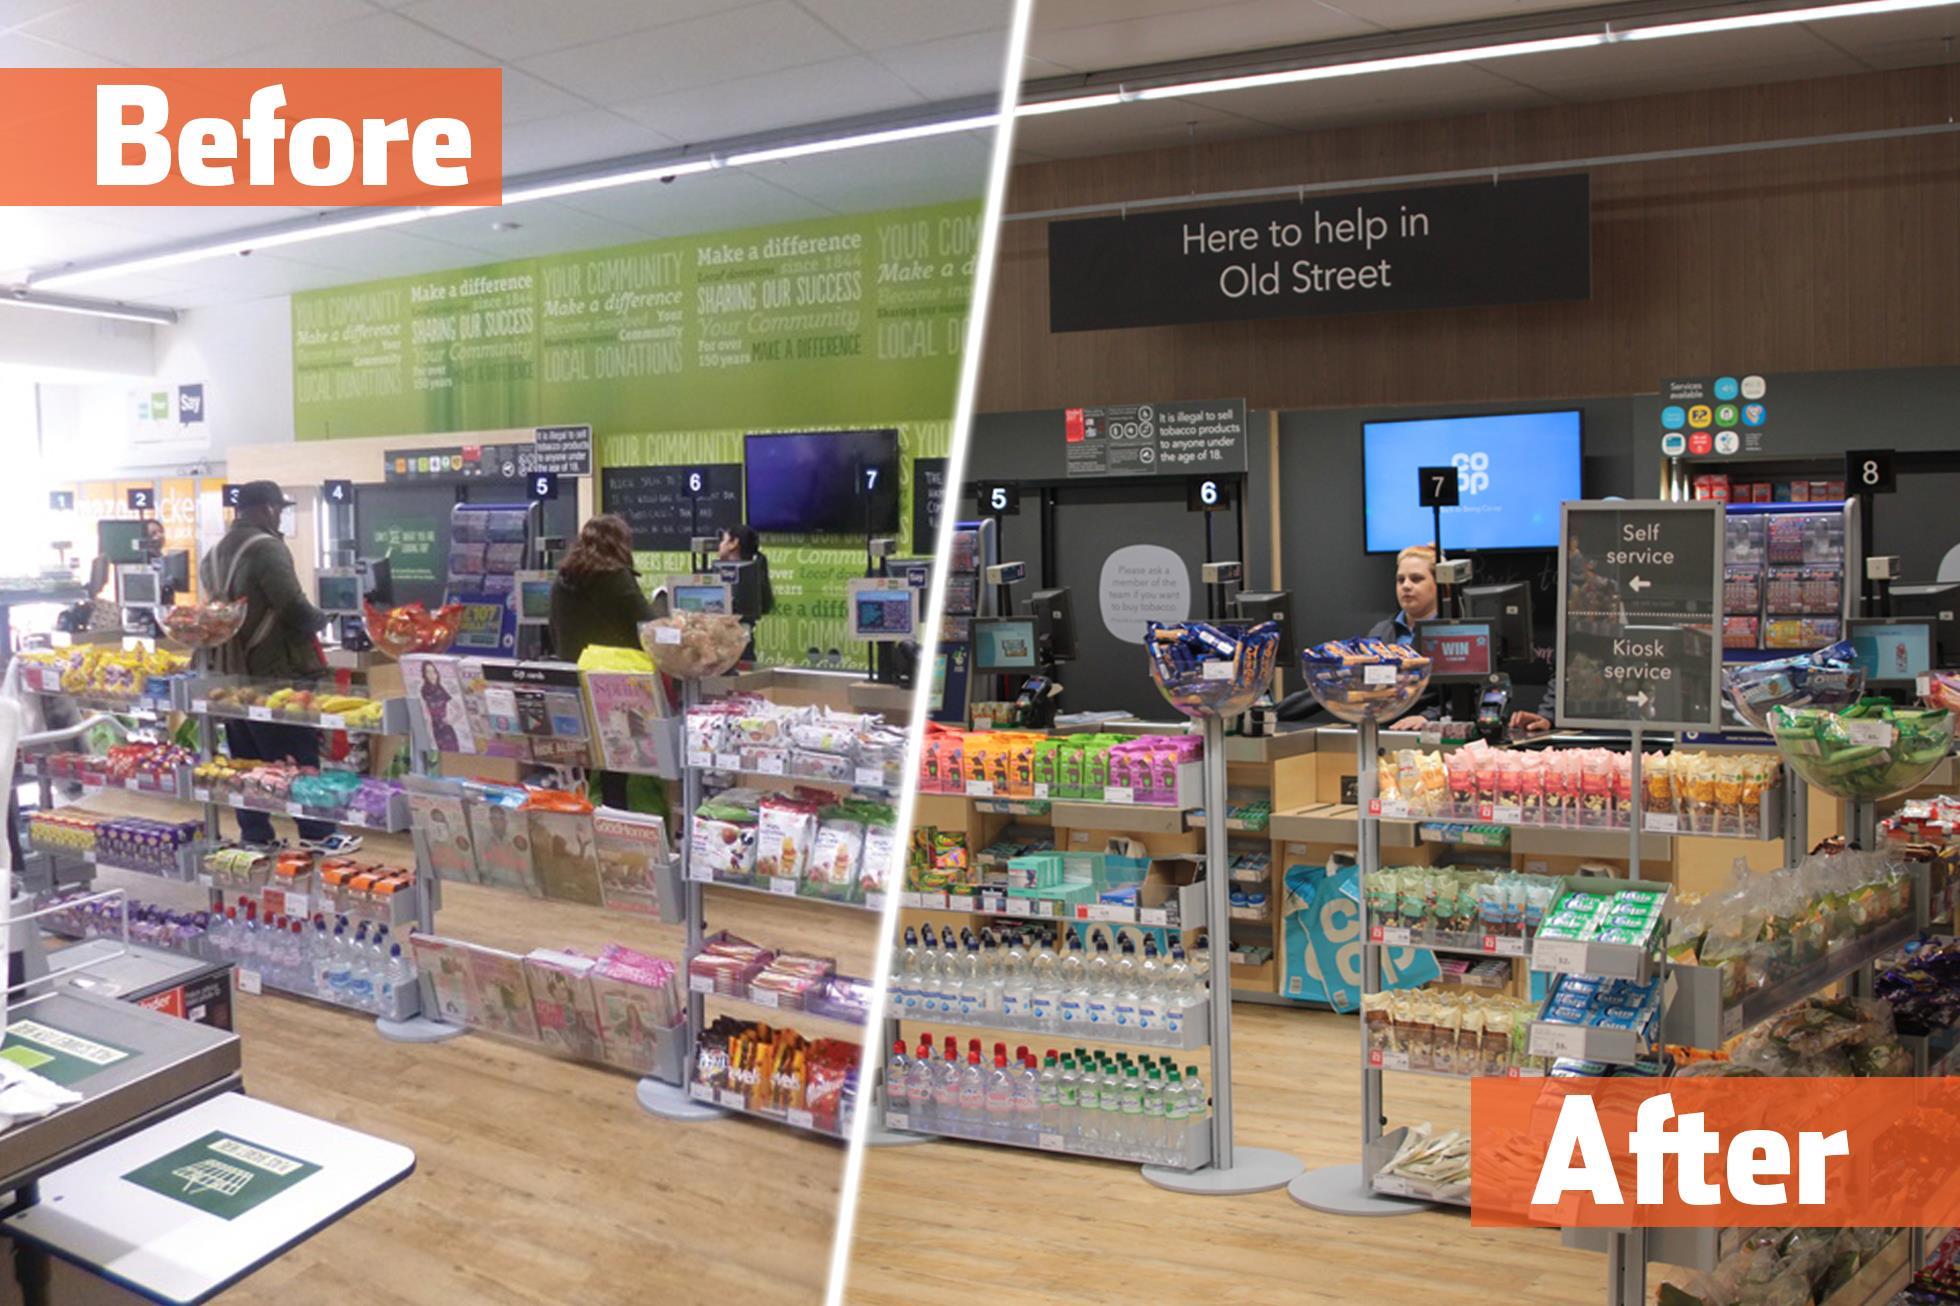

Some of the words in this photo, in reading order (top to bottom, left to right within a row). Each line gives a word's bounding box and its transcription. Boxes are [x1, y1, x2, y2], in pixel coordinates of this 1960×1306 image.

[1183, 221, 1258, 256] Here
[1268, 217, 1303, 248] to
[1314, 205, 1388, 250] help
[1400, 204, 1430, 238] in
[697, 246, 744, 267] Make
[749, 245, 760, 260] a
[762, 233, 863, 260] difference
[876, 220, 930, 262] YOUR
[543, 263, 582, 298] YOUR
[587, 251, 684, 294] COMMUNITY
[876, 260, 935, 284] Make
[940, 262, 954, 278] a
[1219, 261, 1280, 298] Old
[1292, 257, 1392, 294] Street
[411, 285, 446, 303] Make
[448, 285, 458, 298] a
[459, 274, 534, 296] difference
[698, 281, 757, 316] SHARING
[762, 277, 792, 309] OUR
[796, 271, 863, 306] SUCCESS
[543, 298, 585, 318] Make
[589, 300, 600, 312] a
[604, 290, 684, 315] difference
[459, 312, 481, 340] OUR
[485, 307, 534, 338] SUCCESS
[656, 310, 683, 322] Your
[701, 316, 743, 338] Your
[749, 306, 861, 334] Community
[342, 322, 401, 344] difference
[618, 324, 684, 341] Community
[877, 319, 938, 360] LOCAL
[717, 338, 743, 351] over
[797, 333, 863, 361] DIFFERENCE
[544, 348, 590, 382] LOCAL
[594, 341, 684, 379] DONATIONS
[720, 353, 750, 369] years
[1669, 382, 1703, 391] Services
[1669, 391, 1704, 400] available
[1159, 412, 1167, 423] It
[1167, 411, 1176, 423] is
[1176, 410, 1204, 424] illegal
[1205, 410, 1216, 421] to
[1217, 408, 1234, 421] sell
[1159, 425, 1197, 437] tobacco
[1198, 424, 1241, 438] products
[603, 434, 640, 468] YOUR
[645, 430, 743, 467] COMMUNITY
[1160, 440, 1170, 450] to
[1171, 439, 1206, 452] anyone
[1207, 437, 1236, 448] under
[1160, 452, 1176, 462] the
[1177, 452, 1196, 464] age
[1196, 449, 1208, 461] of
[1209, 449, 1224, 461] 18.
[866, 470, 878, 490] 7
[1862, 460, 1880, 485] 8
[535, 478, 548, 495] 5
[689, 472, 702, 492] 6
[1431, 476, 1445, 498] 7
[135, 492, 147, 507] 2
[332, 484, 344, 500] 4
[991, 488, 1007, 510] 5
[1200, 481, 1218, 504] 6
[58, 495, 65, 508] 1
[1623, 523, 1661, 542] Self
[1606, 548, 1675, 565] service
[1117, 565, 1146, 576] Please
[1148, 564, 1163, 575] ask
[1163, 567, 1171, 575] a
[1112, 577, 1149, 588] member
[1150, 577, 1161, 588] of
[1162, 577, 1177, 588] the
[1109, 590, 1132, 601] team
[1132, 589, 1140, 600] if
[1140, 590, 1157, 603] you
[1157, 590, 1181, 601] want
[796, 602, 808, 618] a
[1111, 602, 1122, 612] to
[1122, 601, 1140, 614] buy
[1441, 641, 1470, 656] WIN
[1612, 639, 1665, 657] Kiosk
[512, 669, 527, 679] Gift
[527, 671, 546, 681] cards
[1604, 663, 1672, 680] service
